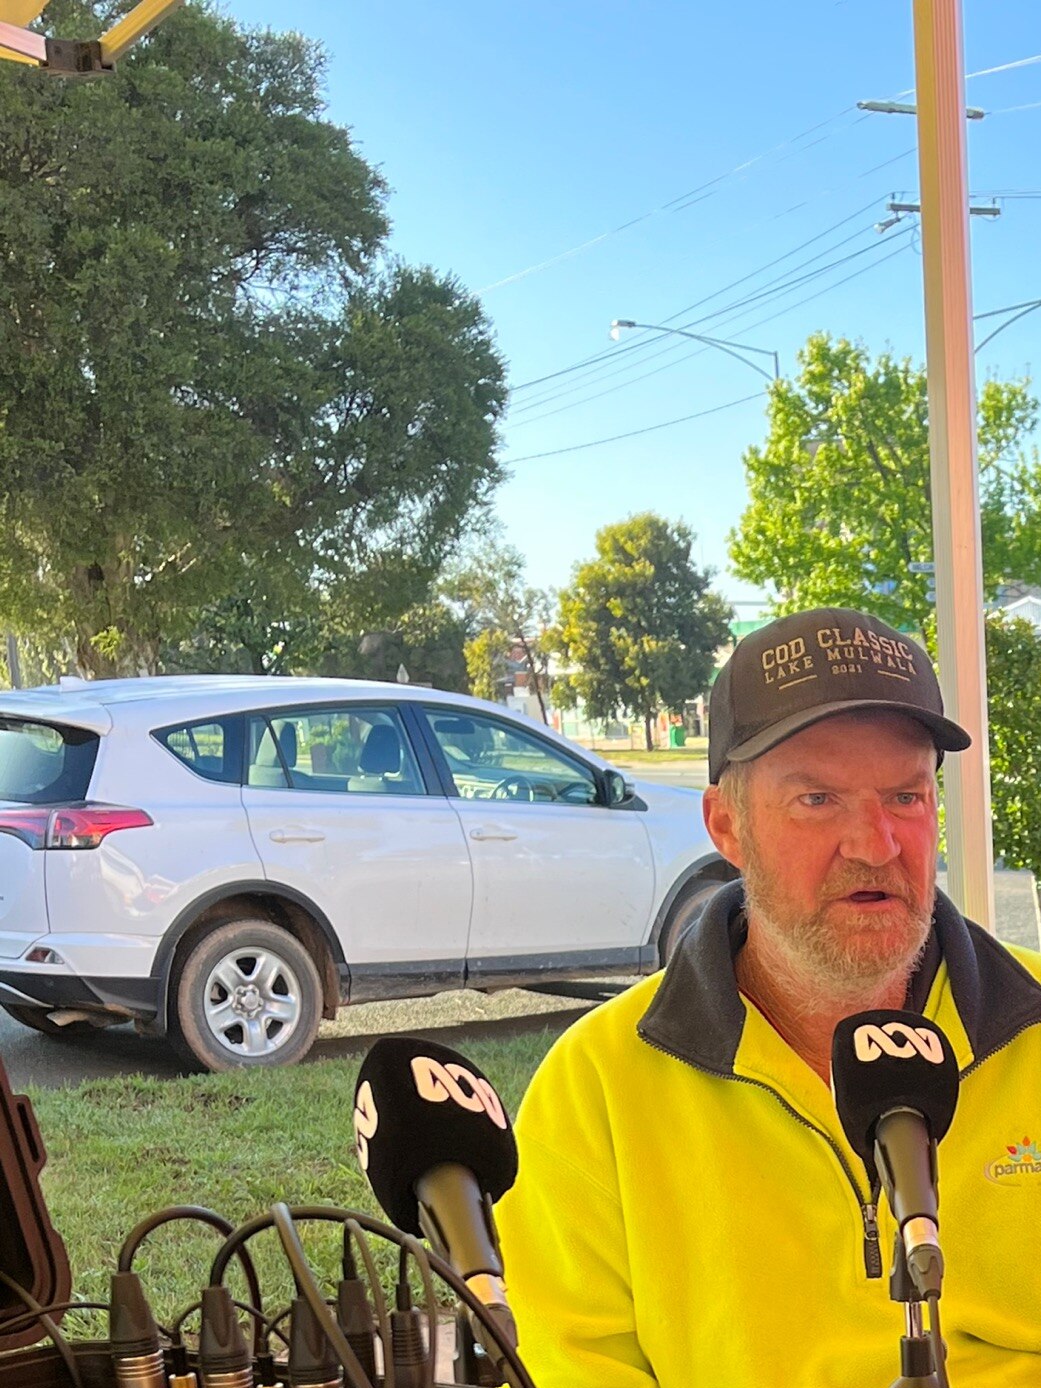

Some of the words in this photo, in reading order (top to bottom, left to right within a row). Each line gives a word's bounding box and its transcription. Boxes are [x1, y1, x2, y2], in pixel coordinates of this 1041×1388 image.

[762, 637, 806, 669] COD
[817, 627, 913, 661] CLASSIC
[764, 655, 814, 684] LAKE
[827, 647, 917, 675] MULWALA
